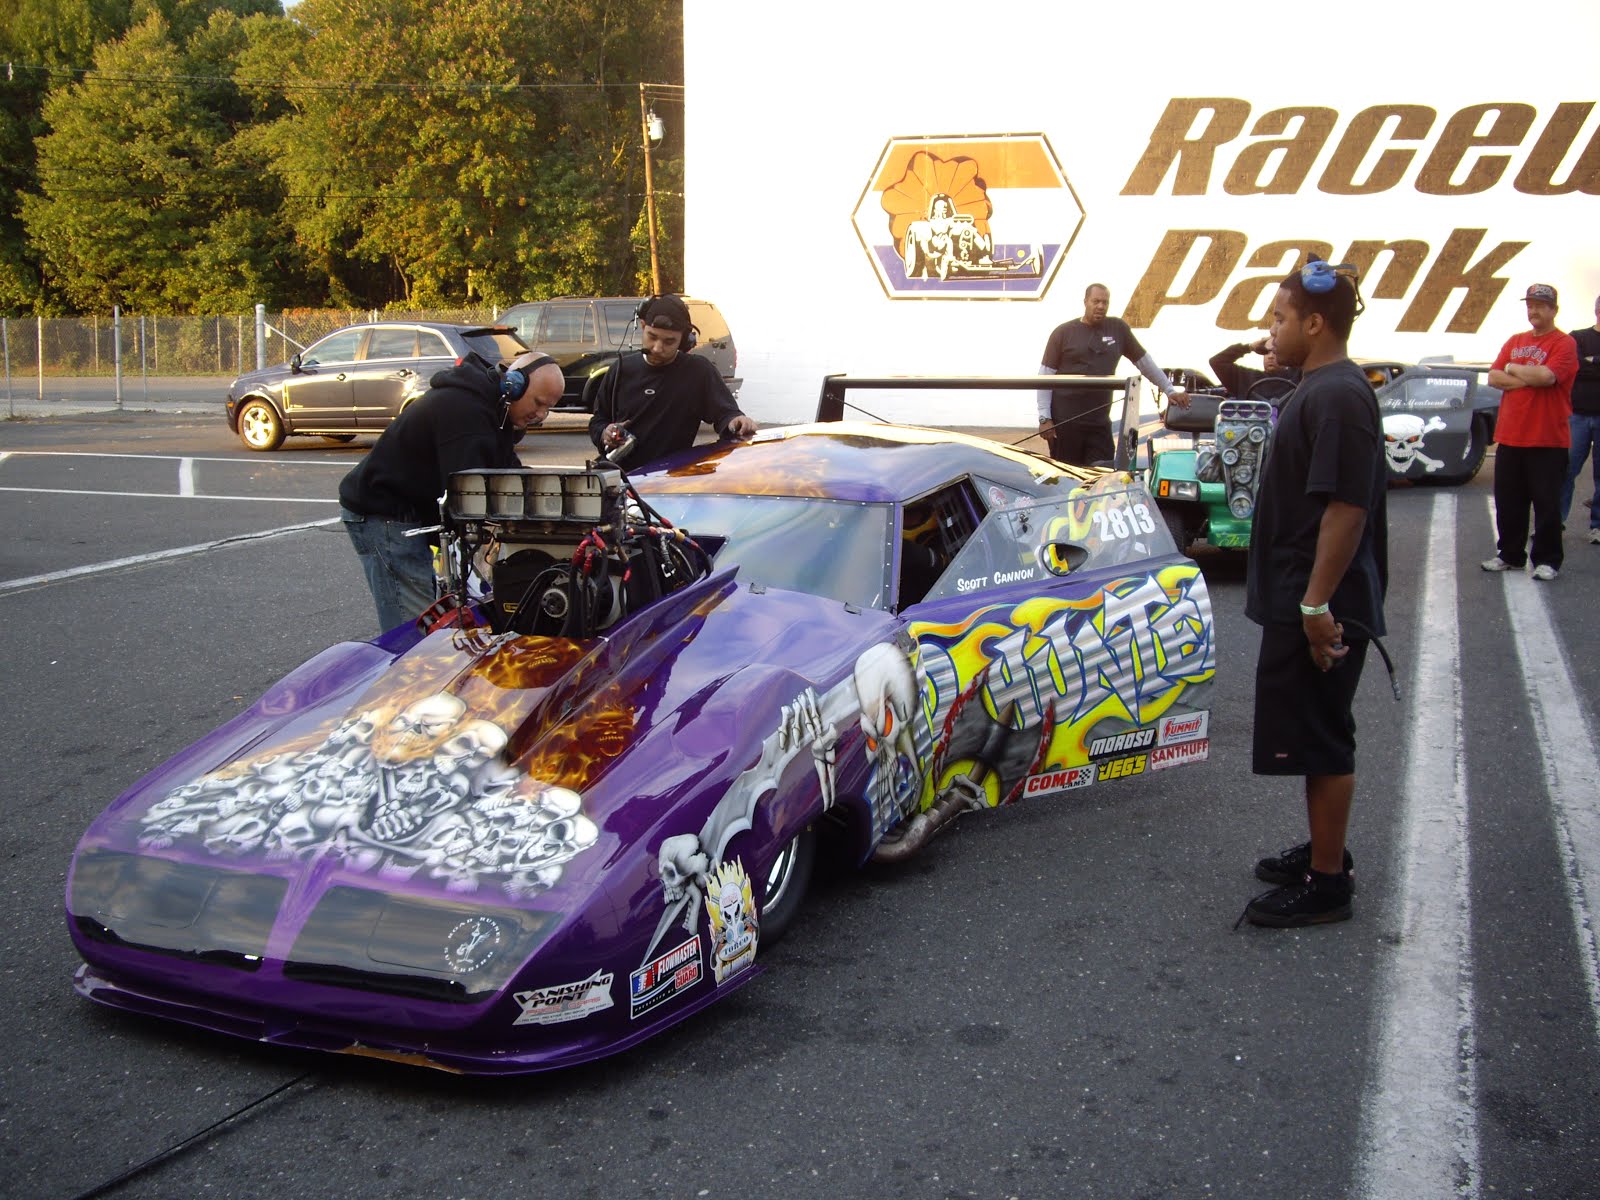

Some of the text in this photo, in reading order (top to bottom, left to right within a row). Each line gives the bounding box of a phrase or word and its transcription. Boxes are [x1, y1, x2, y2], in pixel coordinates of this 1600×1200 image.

[1092, 503, 1156, 542] 2813
[957, 567, 1034, 592] SCOTT CANNON
[1162, 716, 1202, 740] SUMMIT
[1088, 728, 1156, 757] MOROSO
[1152, 740, 1208, 764] SANTHUFF
[1027, 769, 1079, 793] COMP
[1061, 779, 1086, 789] CAMS
[447, 916, 500, 943] ROAD RUNNER
[723, 935, 749, 956] TORCO
[444, 947, 493, 972] SUPERBIRD
[657, 940, 697, 982] FLOWMASTER
[675, 966, 697, 988] GUARD
[516, 976, 611, 1004] VANISHING
[532, 991, 586, 1008] POINT
